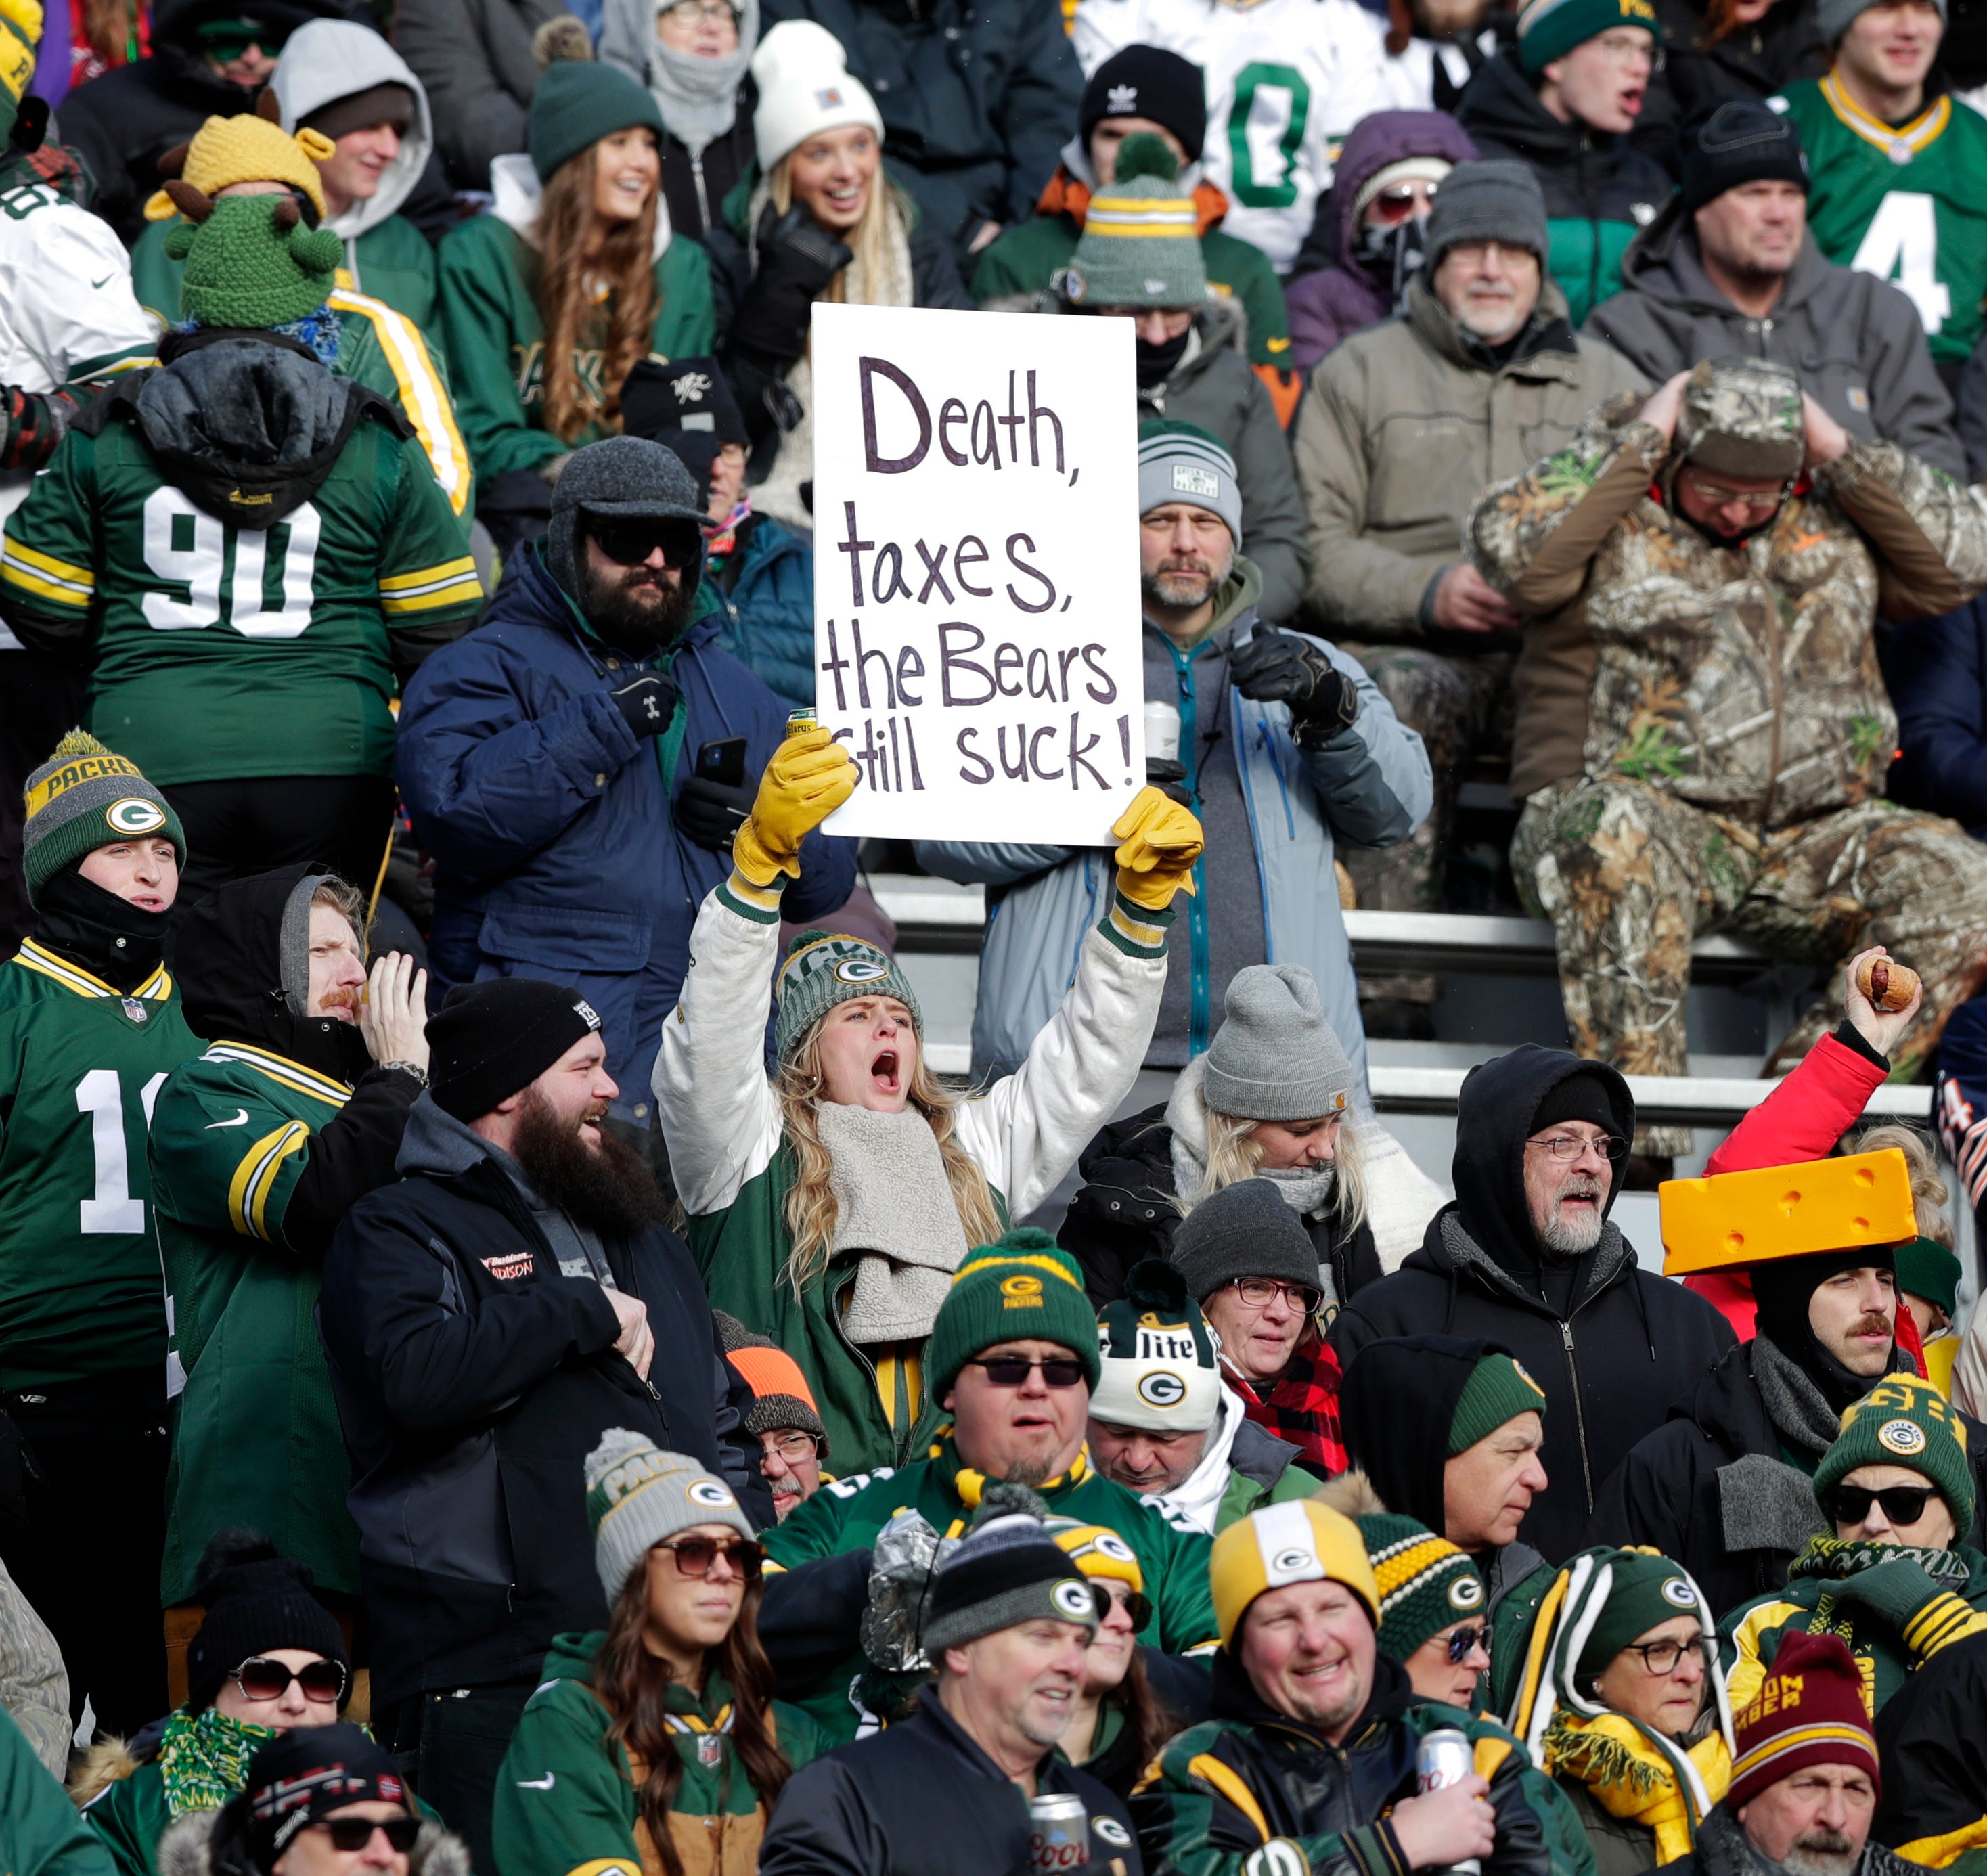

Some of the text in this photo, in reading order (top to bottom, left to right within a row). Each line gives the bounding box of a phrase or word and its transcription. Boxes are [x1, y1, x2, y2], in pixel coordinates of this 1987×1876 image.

[1851, 190, 1951, 334] 4
[859, 356, 1079, 487] Death,
[141, 485, 321, 638] 90
[838, 501, 1072, 613] taxes,
[822, 619, 1117, 710] the Bears
[787, 723, 811, 734] Glarus
[957, 712, 1132, 790] suck!
[1140, 1332, 1195, 1359] lite
